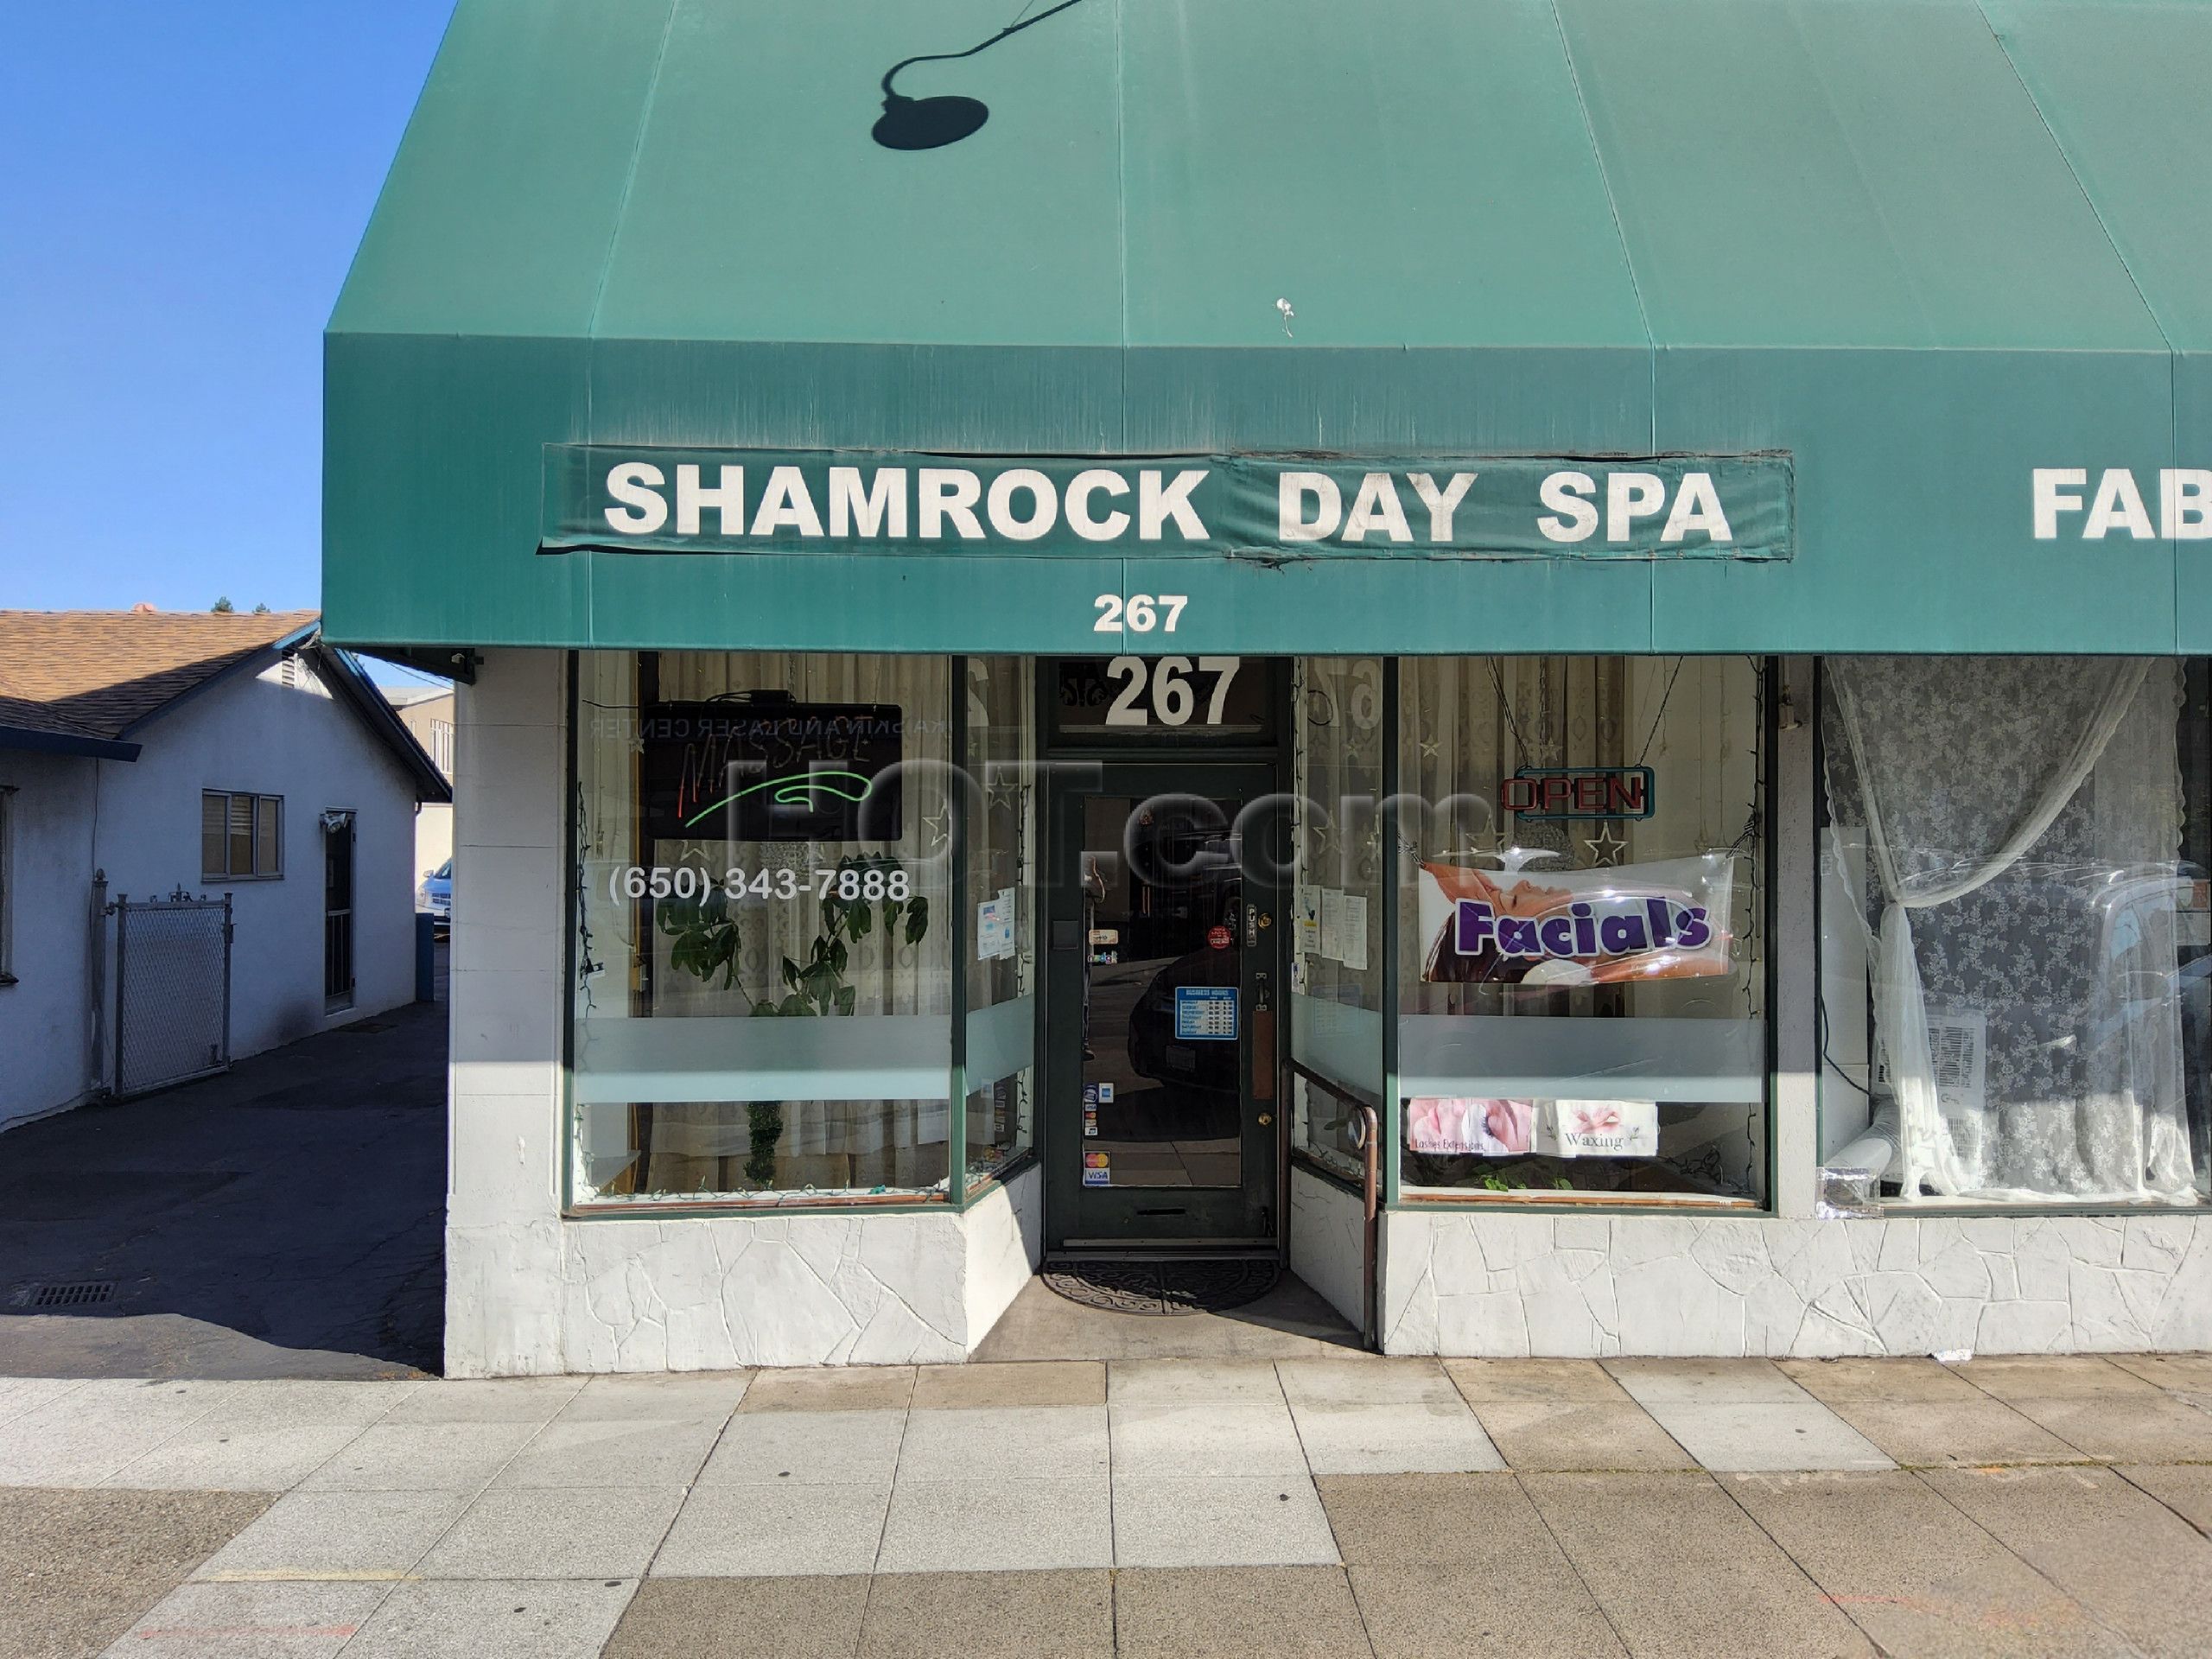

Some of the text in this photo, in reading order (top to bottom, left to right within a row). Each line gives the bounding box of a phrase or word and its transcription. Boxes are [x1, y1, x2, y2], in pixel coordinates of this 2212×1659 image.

[604, 462, 1733, 543] SHAMROCK DAY SPA
[2033, 467, 2212, 539] FAB
[1094, 594, 1188, 632] 267
[1105, 656, 1241, 726] 267
[677, 715, 874, 818] MASSAGE
[1501, 777, 1643, 811] OPEN
[609, 865, 911, 906] (650) 343-7888
[1454, 896, 1713, 959] Facials
[1566, 1133, 1624, 1150] Waxing
[1088, 1171, 1109, 1180] VISA
